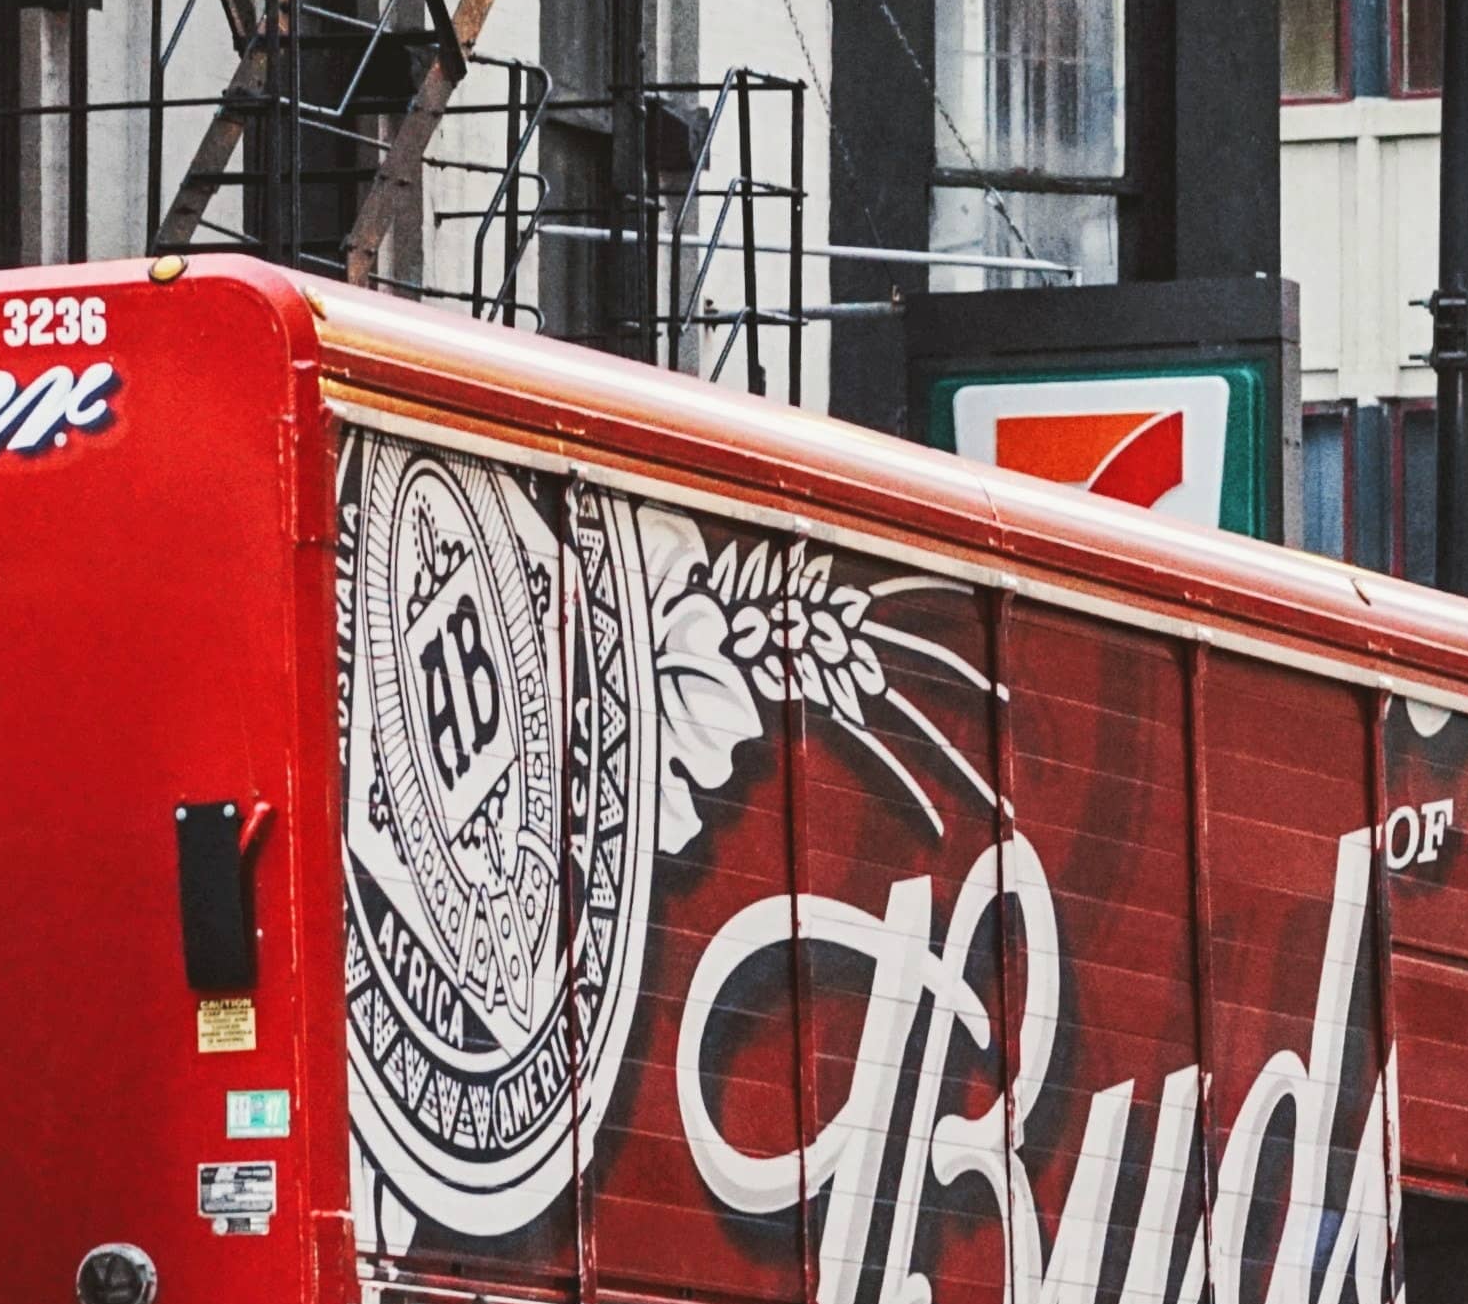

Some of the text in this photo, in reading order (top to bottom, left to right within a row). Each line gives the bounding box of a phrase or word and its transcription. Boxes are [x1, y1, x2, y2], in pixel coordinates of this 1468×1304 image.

[1, 297, 108, 348] 3236
[1384, 798, 1455, 871] OF
[378, 910, 465, 1050] AFRICA
